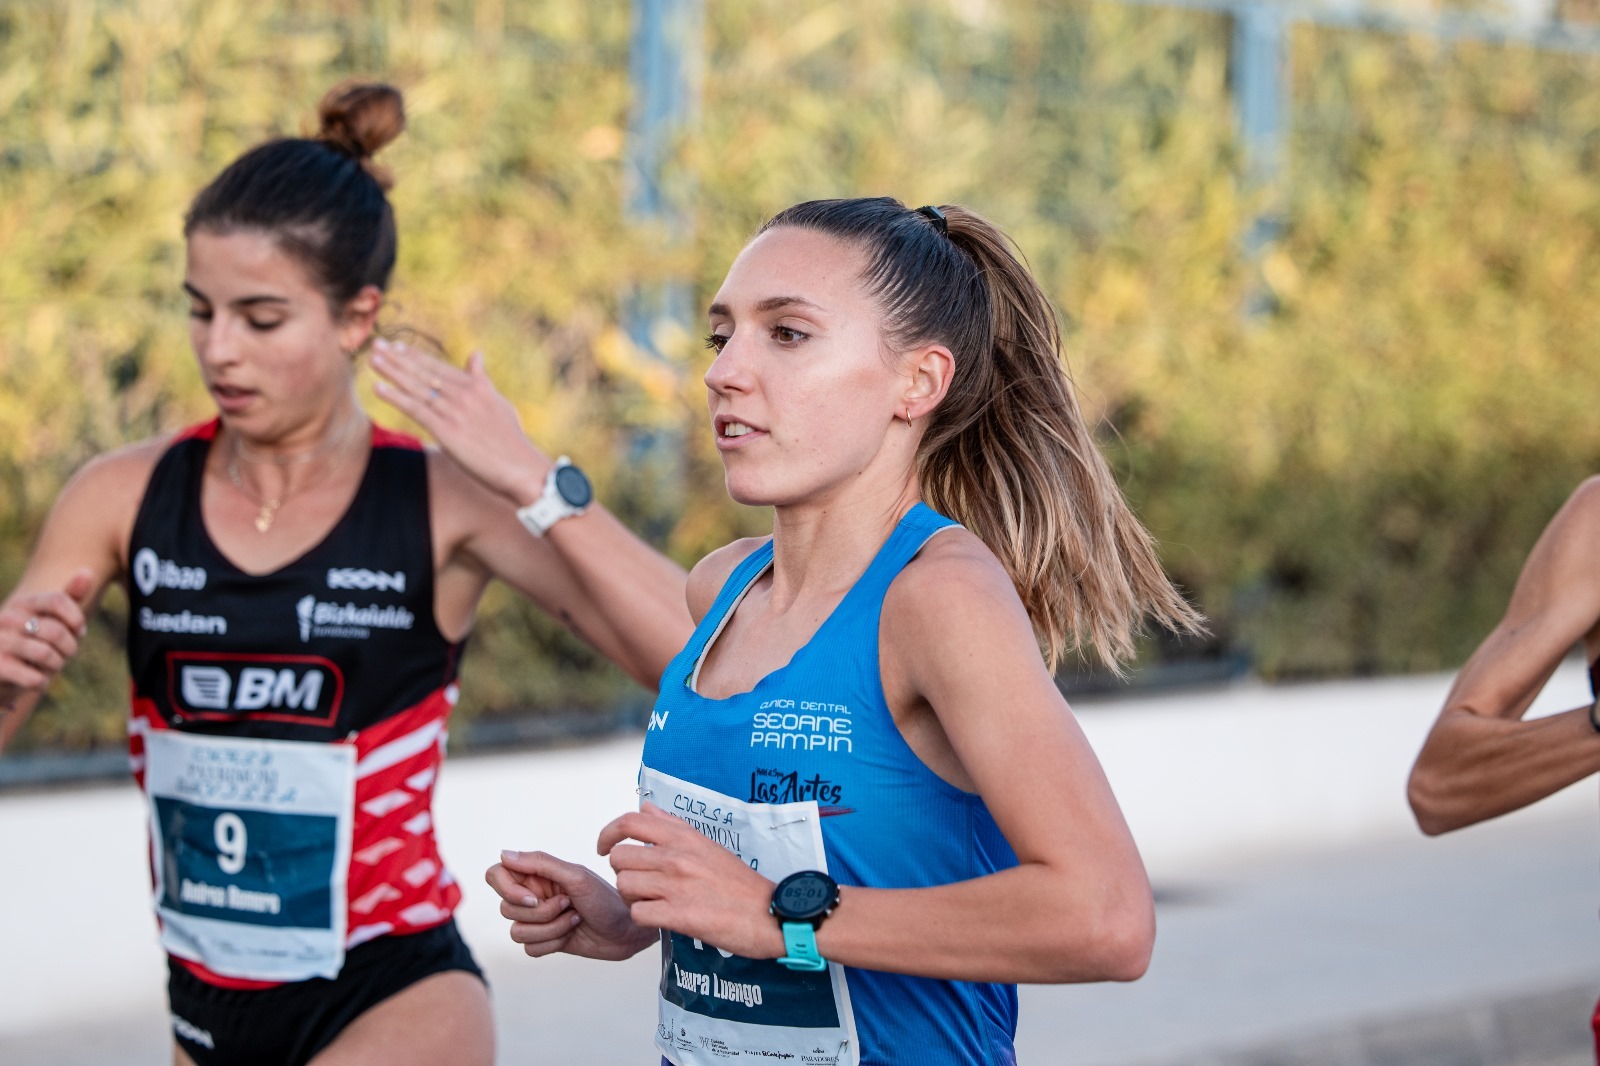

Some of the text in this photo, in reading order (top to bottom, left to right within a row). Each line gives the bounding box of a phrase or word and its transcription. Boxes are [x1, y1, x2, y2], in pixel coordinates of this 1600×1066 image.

[234, 667, 325, 711] BM
[753, 712, 852, 735] SEOANE
[800, 701, 852, 715] DENTAL
[750, 731, 853, 754] PAMPIN
[748, 770, 842, 804] Las Artes
[673, 794, 733, 826] CURSA
[213, 812, 248, 875] 9
[674, 962, 763, 1008] Laura Luengo
